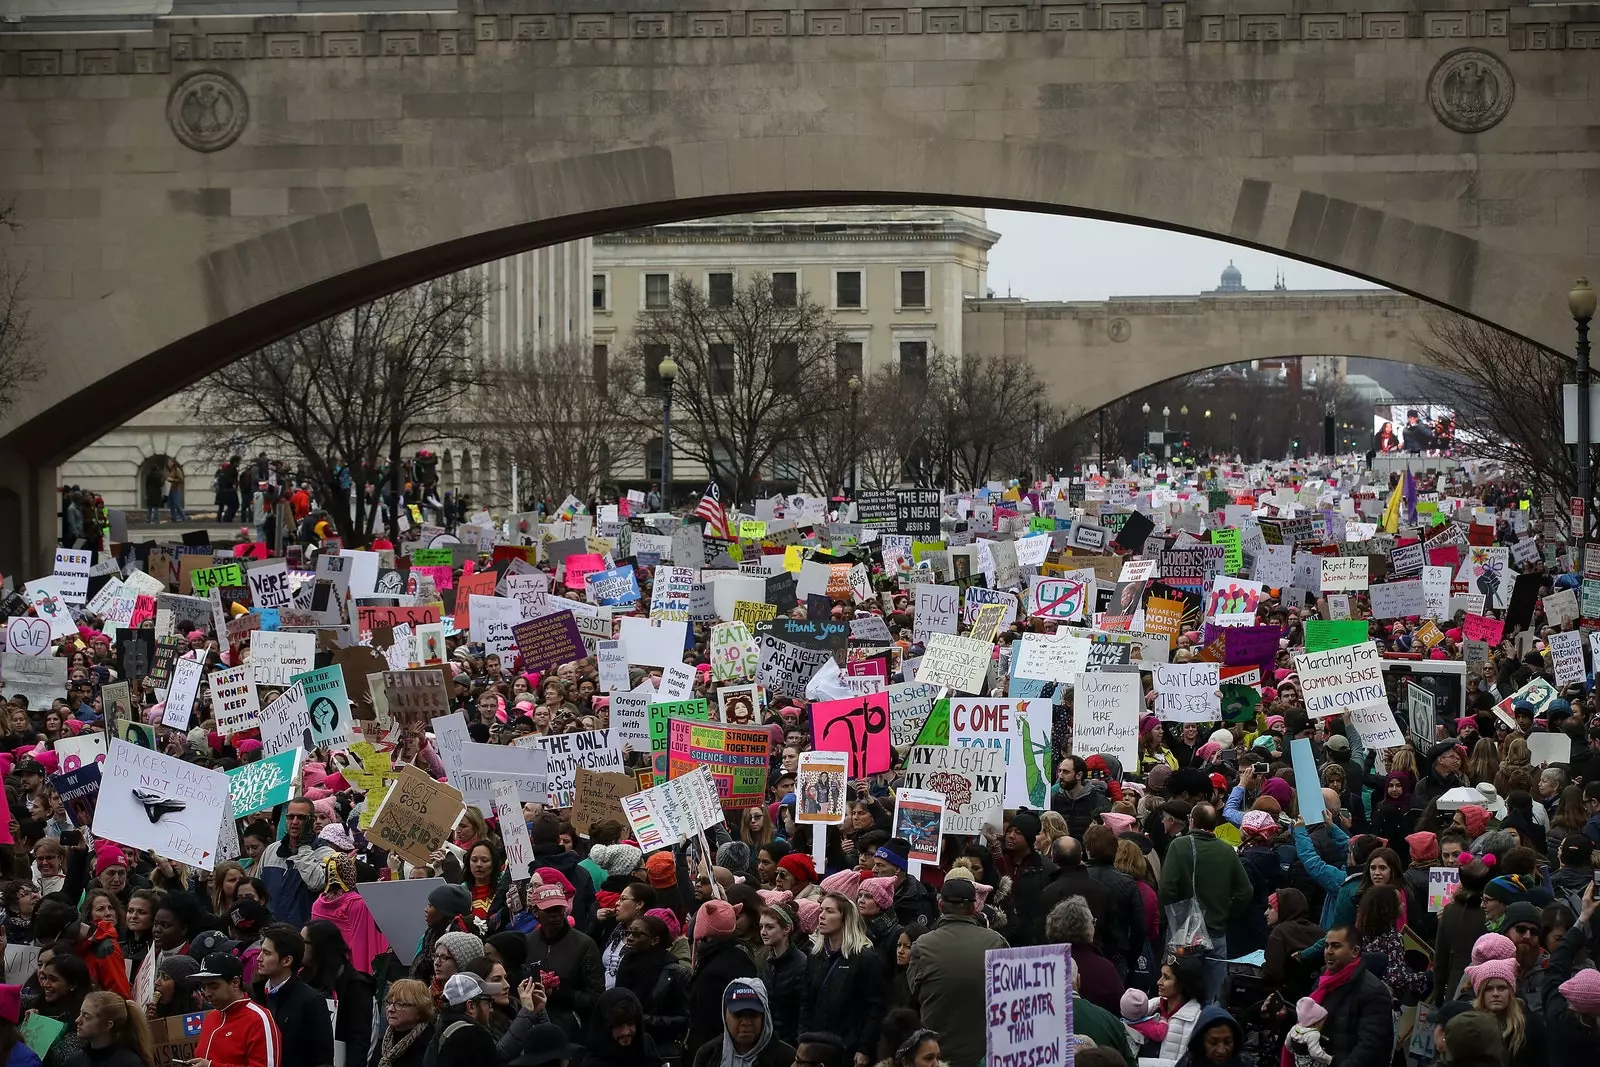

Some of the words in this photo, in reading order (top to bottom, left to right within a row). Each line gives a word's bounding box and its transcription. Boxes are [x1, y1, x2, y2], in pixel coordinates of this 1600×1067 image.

[897, 492, 918, 503] THE
[919, 492, 938, 503] END
[899, 507, 908, 519] IS
[911, 507, 939, 519] NEAR!
[905, 522, 923, 531] JESUS
[924, 522, 930, 530] IS
[1282, 525, 1312, 535] TRUMPS
[884, 537, 910, 546] FREE
[921, 535, 940, 543] SOON!
[56, 554, 87, 564] QUEER
[1161, 552, 1203, 565] WOMEN'S
[1322, 559, 1346, 571] Reject
[1349, 558, 1367, 570] Perry
[197, 565, 236, 585] HATE
[741, 566, 772, 575] AMERICA
[1162, 566, 1203, 577] RIGHTS
[1323, 573, 1346, 582] Science
[250, 571, 289, 594] WE'RE
[460, 582, 495, 595] FACTS
[596, 578, 617, 587] ABORTO
[617, 579, 632, 588] LEGAL
[261, 590, 290, 606] STILL
[967, 588, 1000, 604] NURSES
[1041, 584, 1075, 616] 45
[759, 603, 774, 611] WHAT
[922, 594, 956, 614] FUCK
[514, 622, 542, 634] STRUGGLE
[553, 613, 571, 623] NEVER
[576, 618, 609, 632] ESIST
[1145, 614, 1180, 625] NOISY
[489, 624, 508, 634] girls
[517, 629, 538, 640] ENDING
[785, 620, 816, 633] thank
[820, 622, 844, 640] you
[1145, 623, 1178, 633] MAJORITY
[13, 630, 48, 648] LOVE
[519, 634, 544, 646] FREEDOM
[550, 627, 568, 638] NEVER
[521, 641, 540, 652] REALLY
[558, 634, 567, 642] YOU
[714, 626, 750, 647] DEATH
[932, 633, 968, 648] MARCHING
[967, 639, 987, 652] FOR
[523, 649, 537, 657] EARN
[543, 644, 556, 652] AND
[766, 637, 786, 652] OUR
[791, 647, 829, 664] RIGHTS
[1554, 642, 1569, 650] COULD
[525, 654, 541, 663] EVERY
[725, 647, 740, 660] TO
[927, 645, 979, 667] PROGRESSIVE
[979, 660, 987, 669] &
[1089, 656, 1121, 664] ALIVE
[1296, 652, 1353, 672] Marching
[1353, 645, 1377, 662] For
[1553, 648, 1581, 660] PREGNANT
[711, 654, 759, 681] NAZIS
[924, 658, 976, 679] INCLUSIVE
[1555, 658, 1582, 667] ABORTION
[216, 672, 245, 685] NASTY
[315, 672, 329, 682] THE
[669, 667, 690, 680] Oregon
[761, 662, 773, 671] UP
[776, 670, 792, 681] FOR
[1158, 667, 1187, 687] CAN'T
[1189, 667, 1217, 687] GRAB
[1249, 673, 1256, 681] IS
[385, 671, 440, 687] FEMALE
[667, 678, 686, 690] stands
[926, 671, 968, 690] AMERICA
[1302, 674, 1342, 691] COMMON
[1346, 667, 1379, 684] SENSE
[218, 685, 248, 698] WOMEN
[668, 689, 681, 698] with
[1307, 693, 1333, 712] GUN
[1335, 683, 1388, 706] CONTROL
[224, 699, 247, 710] KEEP
[259, 708, 271, 725] WE
[271, 697, 285, 717] WILL
[284, 682, 304, 709] NOT
[397, 692, 440, 706] LIVES
[616, 696, 647, 707] Oregon
[1161, 692, 1182, 710] THIS
[278, 708, 289, 725] BE
[616, 709, 645, 718] stands
[651, 701, 705, 719] PLEASE
[1093, 712, 1112, 722] ARE
[1363, 709, 1388, 724] Paris
[218, 710, 259, 726] FIGHTING
[622, 720, 640, 729] with
[264, 712, 311, 755] TRUMPLED
[672, 722, 690, 734] LOVE
[693, 727, 724, 740] JUSTICE
[1075, 723, 1106, 736] Human
[538, 735, 571, 754] THE
[576, 730, 610, 750] ONLY
[628, 731, 651, 740] press.
[680, 733, 689, 742] IS
[726, 731, 768, 743] STRONGER
[671, 742, 688, 753] LOVE
[726, 743, 766, 753] TOGETHER
[588, 748, 620, 769] Should
[691, 750, 723, 762] SCIENCE
[728, 755, 738, 764] IS
[744, 756, 765, 765] REAL
[912, 749, 935, 765] MY
[938, 747, 998, 774] RIGHT
[116, 745, 168, 775] PLACES
[175, 765, 213, 791] LAWS
[67, 774, 79, 785] MY
[114, 765, 129, 778] DO
[140, 775, 171, 791] NOT
[462, 774, 492, 792] TRUMP
[742, 777, 758, 785] NOT
[905, 773, 926, 790] MY
[976, 774, 1001, 792] MY
[60, 781, 100, 801] MOTIVATION
[402, 776, 437, 804] NOT
[604, 782, 616, 793] my
[400, 795, 427, 814] GOOD
[625, 793, 647, 817] LOVE
[968, 794, 1003, 815] BODY
[946, 816, 983, 831] HOICE
[381, 827, 406, 847] OUR
[407, 823, 440, 851] KIDS
[639, 830, 664, 850] LOVE
[915, 844, 937, 852] MARCH
[992, 961, 1056, 995] EQUALITY
[990, 1002, 1007, 1027] IS
[1011, 992, 1056, 1023] GREATER
[1007, 1019, 1034, 1045] THAN
